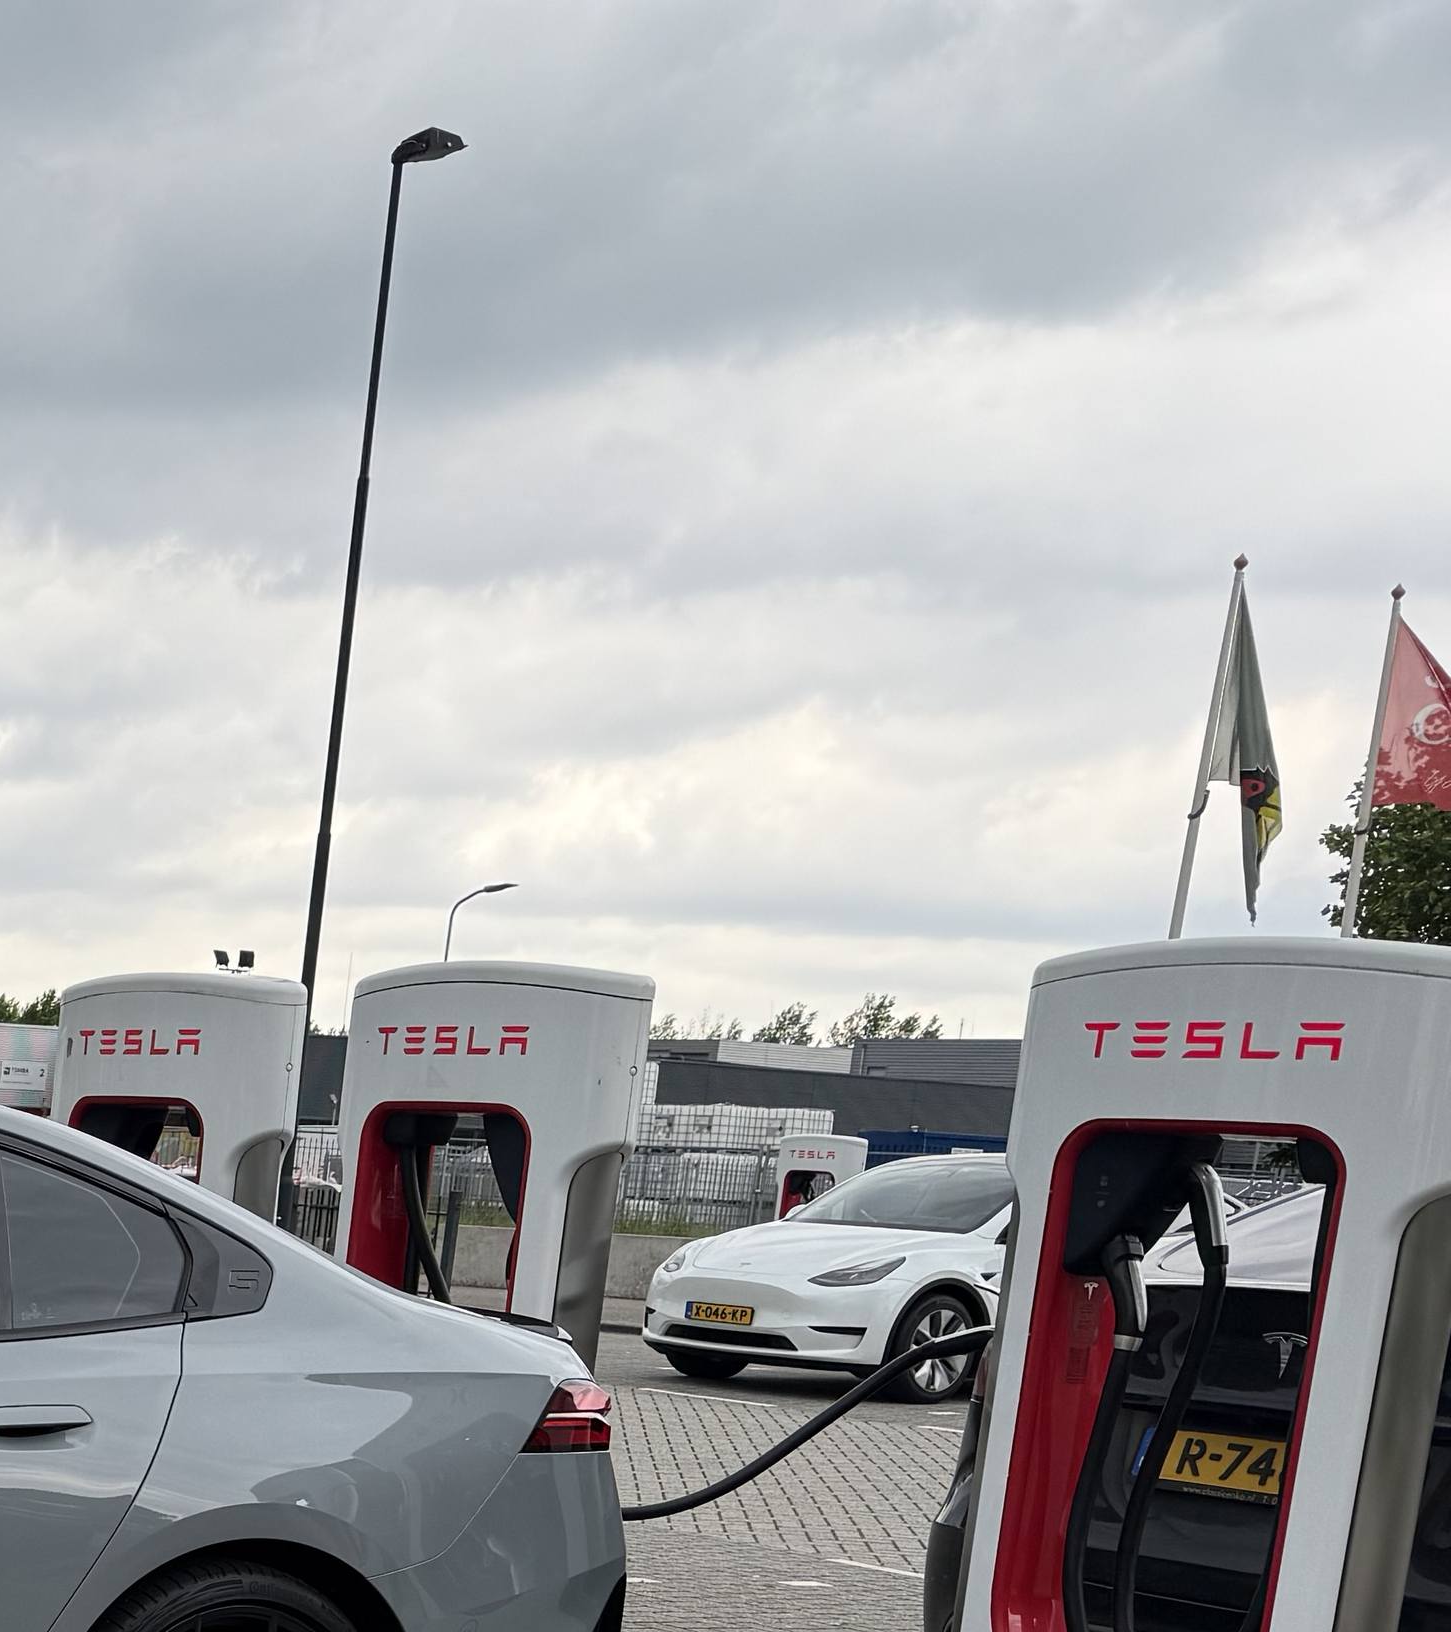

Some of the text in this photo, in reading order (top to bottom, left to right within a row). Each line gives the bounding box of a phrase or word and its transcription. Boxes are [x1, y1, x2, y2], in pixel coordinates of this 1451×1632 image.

[79, 1029, 201, 1055] TESLA
[377, 1026, 530, 1055] TESLA
[1084, 1021, 1346, 1061] TESLA
[789, 1149, 835, 1160] TESLA
[694, 1304, 748, 1322] X-046-KP
[1175, 1437, 1284, 1486] R-74
